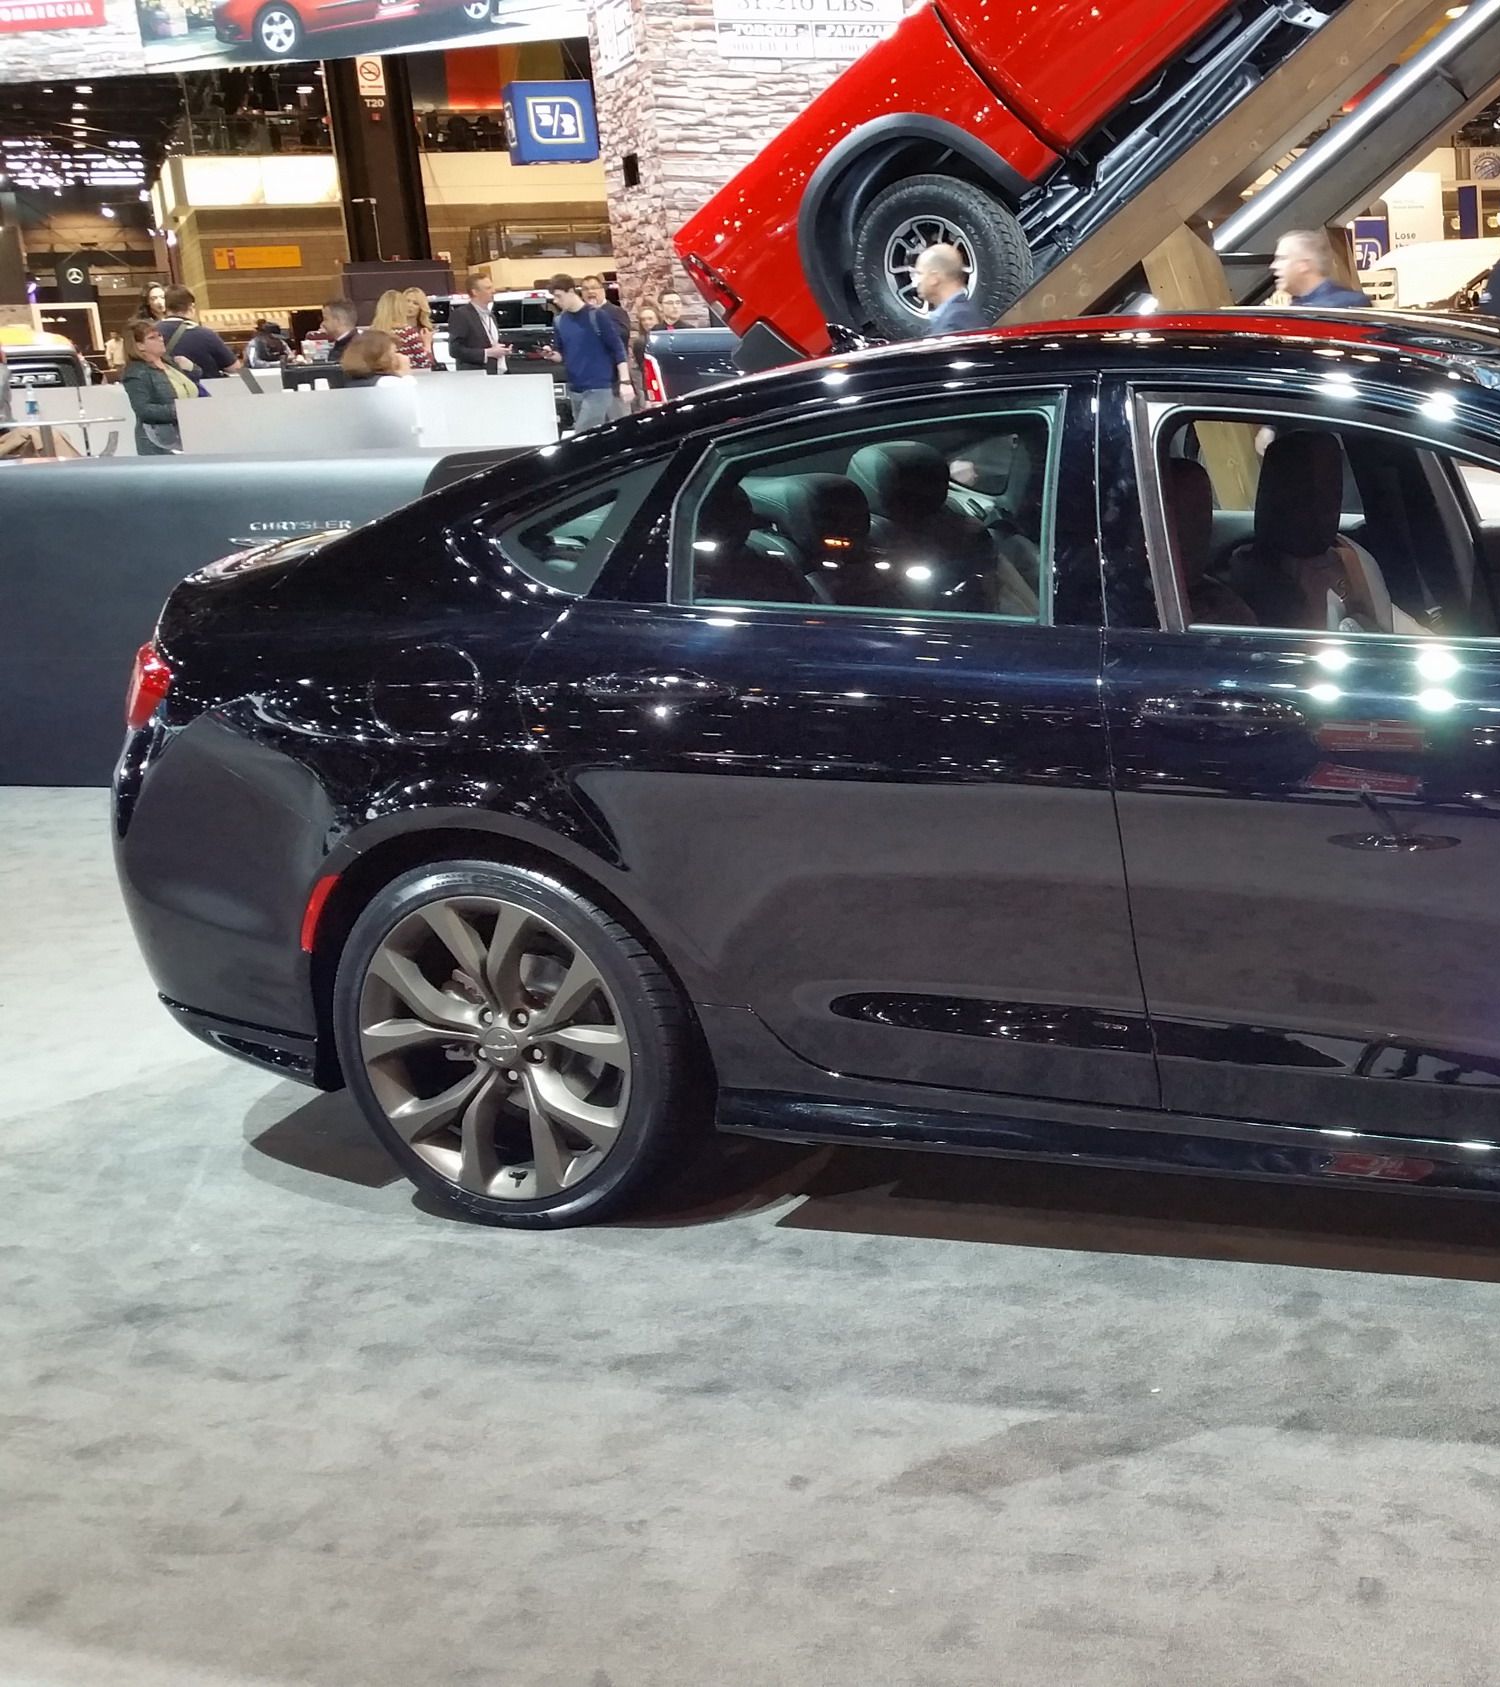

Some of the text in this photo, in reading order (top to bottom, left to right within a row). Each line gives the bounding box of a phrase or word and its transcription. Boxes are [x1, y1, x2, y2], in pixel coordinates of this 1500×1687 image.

[0, 2, 94, 21] OMMERCIAL
[732, 24, 798, 37] TORQUE
[825, 24, 886, 37] PAYLOA
[364, 98, 385, 108] T20
[1394, 232, 1416, 240] Lose
[249, 520, 352, 531] CHRYSLER
